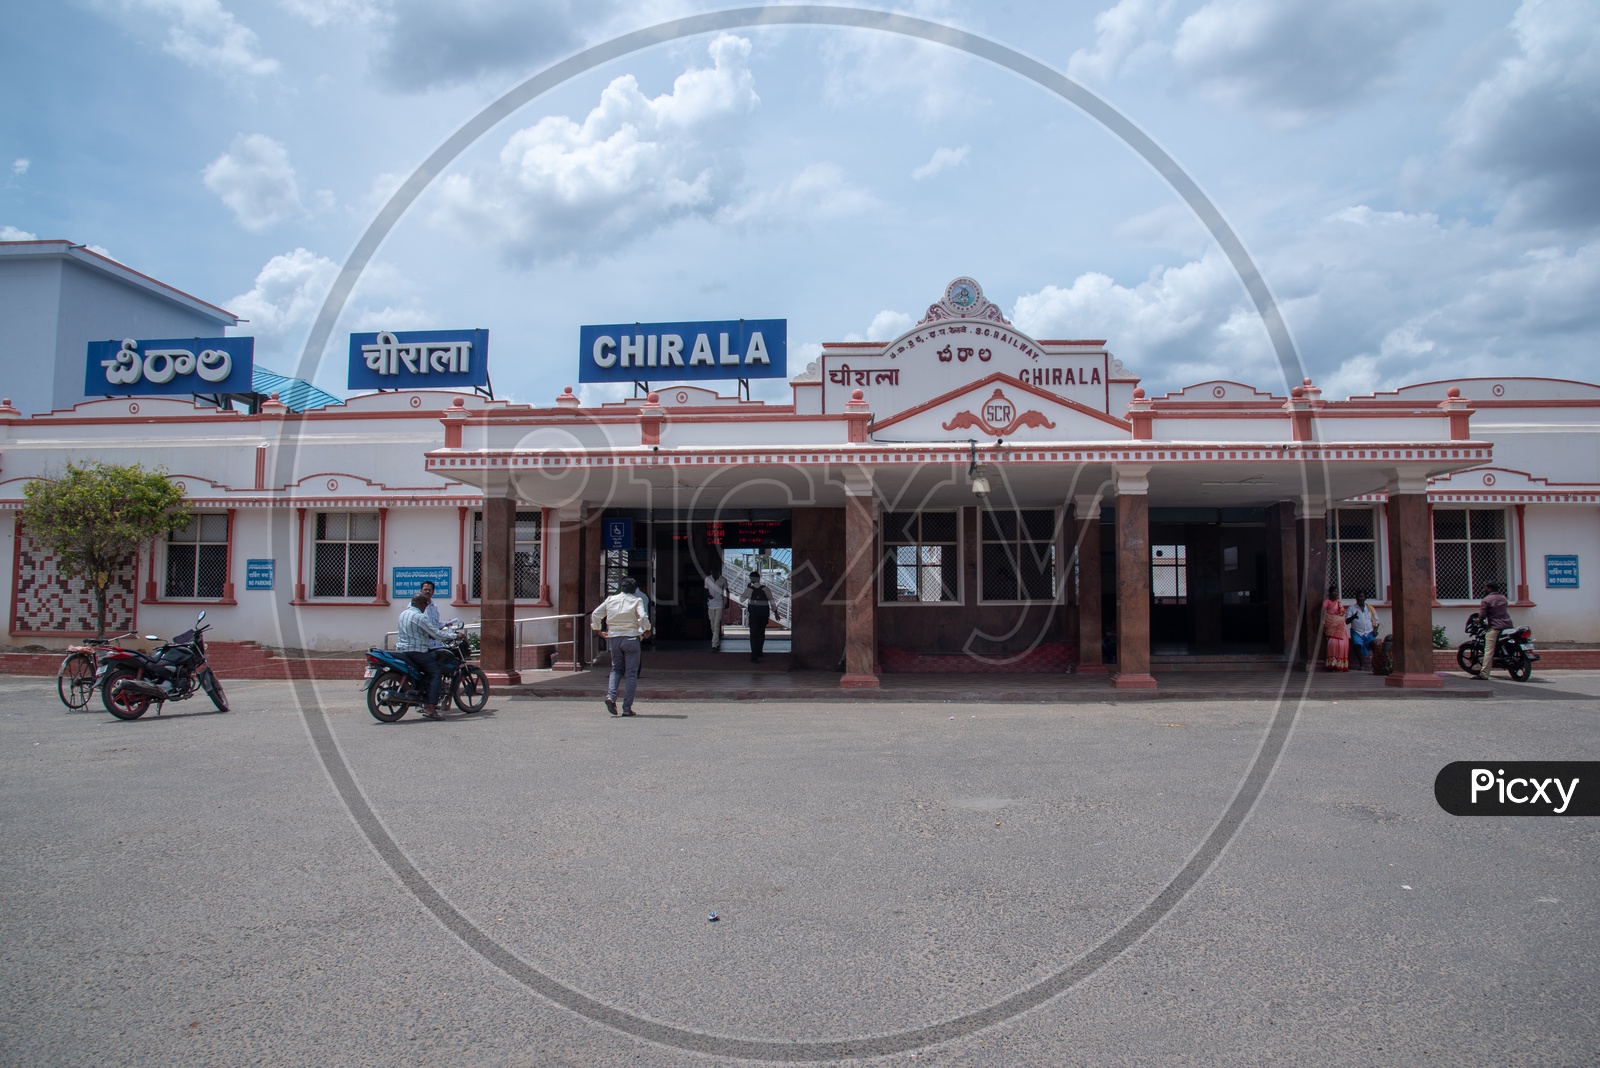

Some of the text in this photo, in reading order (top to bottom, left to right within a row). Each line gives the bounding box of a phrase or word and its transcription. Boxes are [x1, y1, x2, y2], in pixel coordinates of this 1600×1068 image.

[101, 338, 232, 385] చీరాల
[361, 331, 472, 375] चीराला
[592, 331, 770, 368] CHIRALA
[829, 363, 900, 386] चीराला
[1019, 367, 1102, 386] CHIRALA
[986, 405, 1011, 422] SCR
